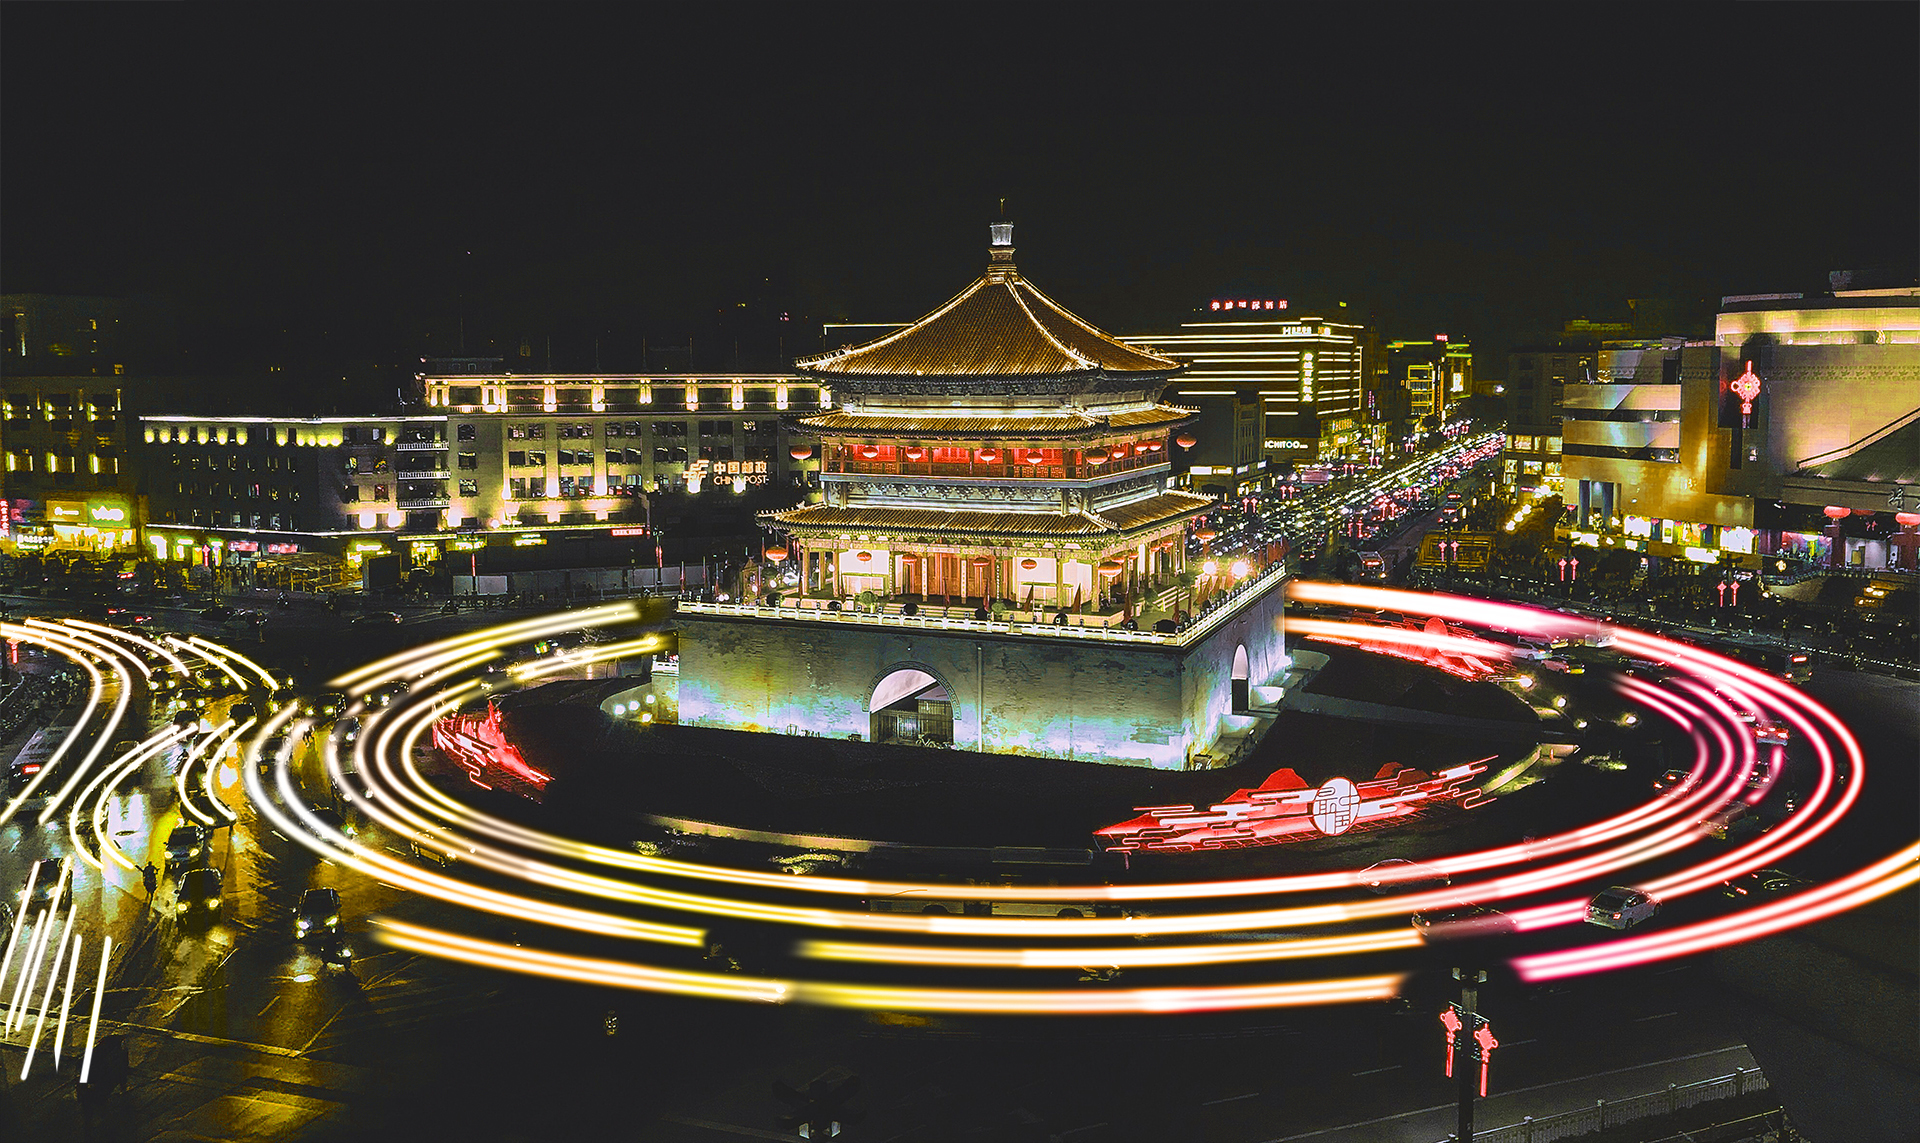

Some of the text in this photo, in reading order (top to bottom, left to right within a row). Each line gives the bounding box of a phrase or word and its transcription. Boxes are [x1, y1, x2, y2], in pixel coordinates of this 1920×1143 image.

[1264, 440, 1300, 449] ICHITOO
[713, 460, 767, 475] 中国邮政
[744, 474, 768, 484] POST
